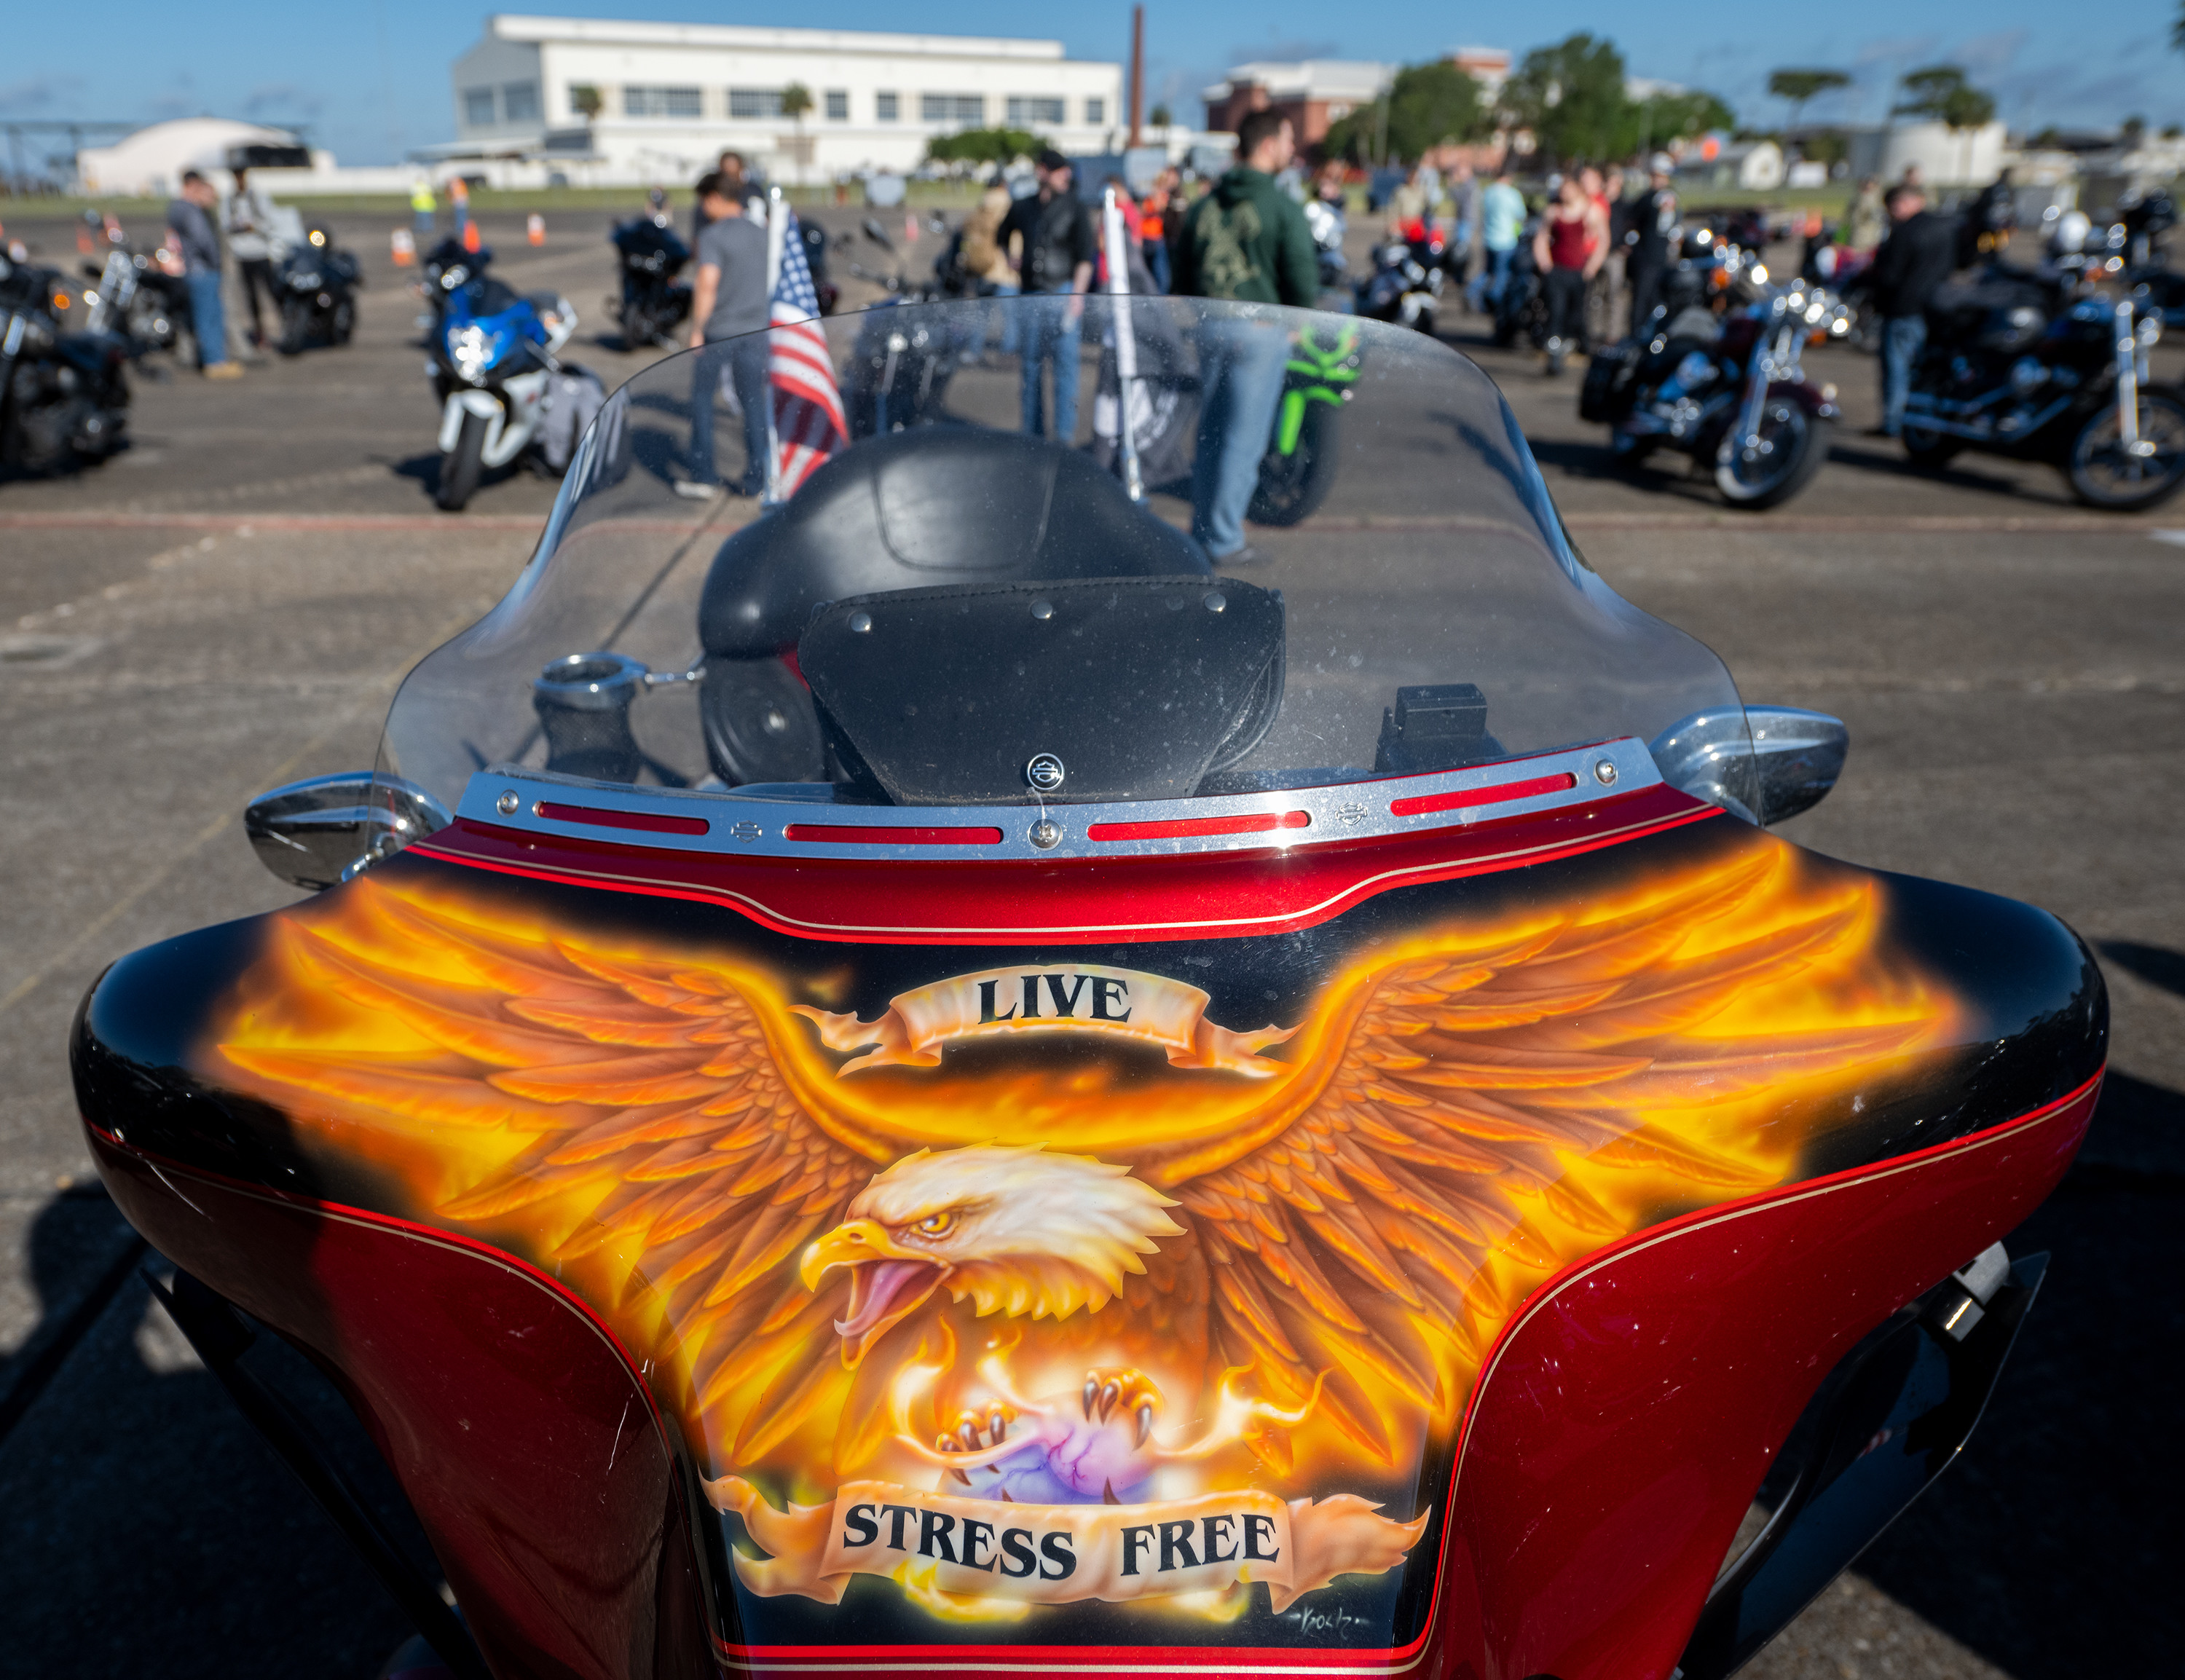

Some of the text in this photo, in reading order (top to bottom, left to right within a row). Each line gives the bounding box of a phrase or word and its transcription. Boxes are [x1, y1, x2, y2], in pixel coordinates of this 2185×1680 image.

[977, 974, 1132, 1025] LIVE
[843, 1503, 1280, 1581] STRESS FREE
